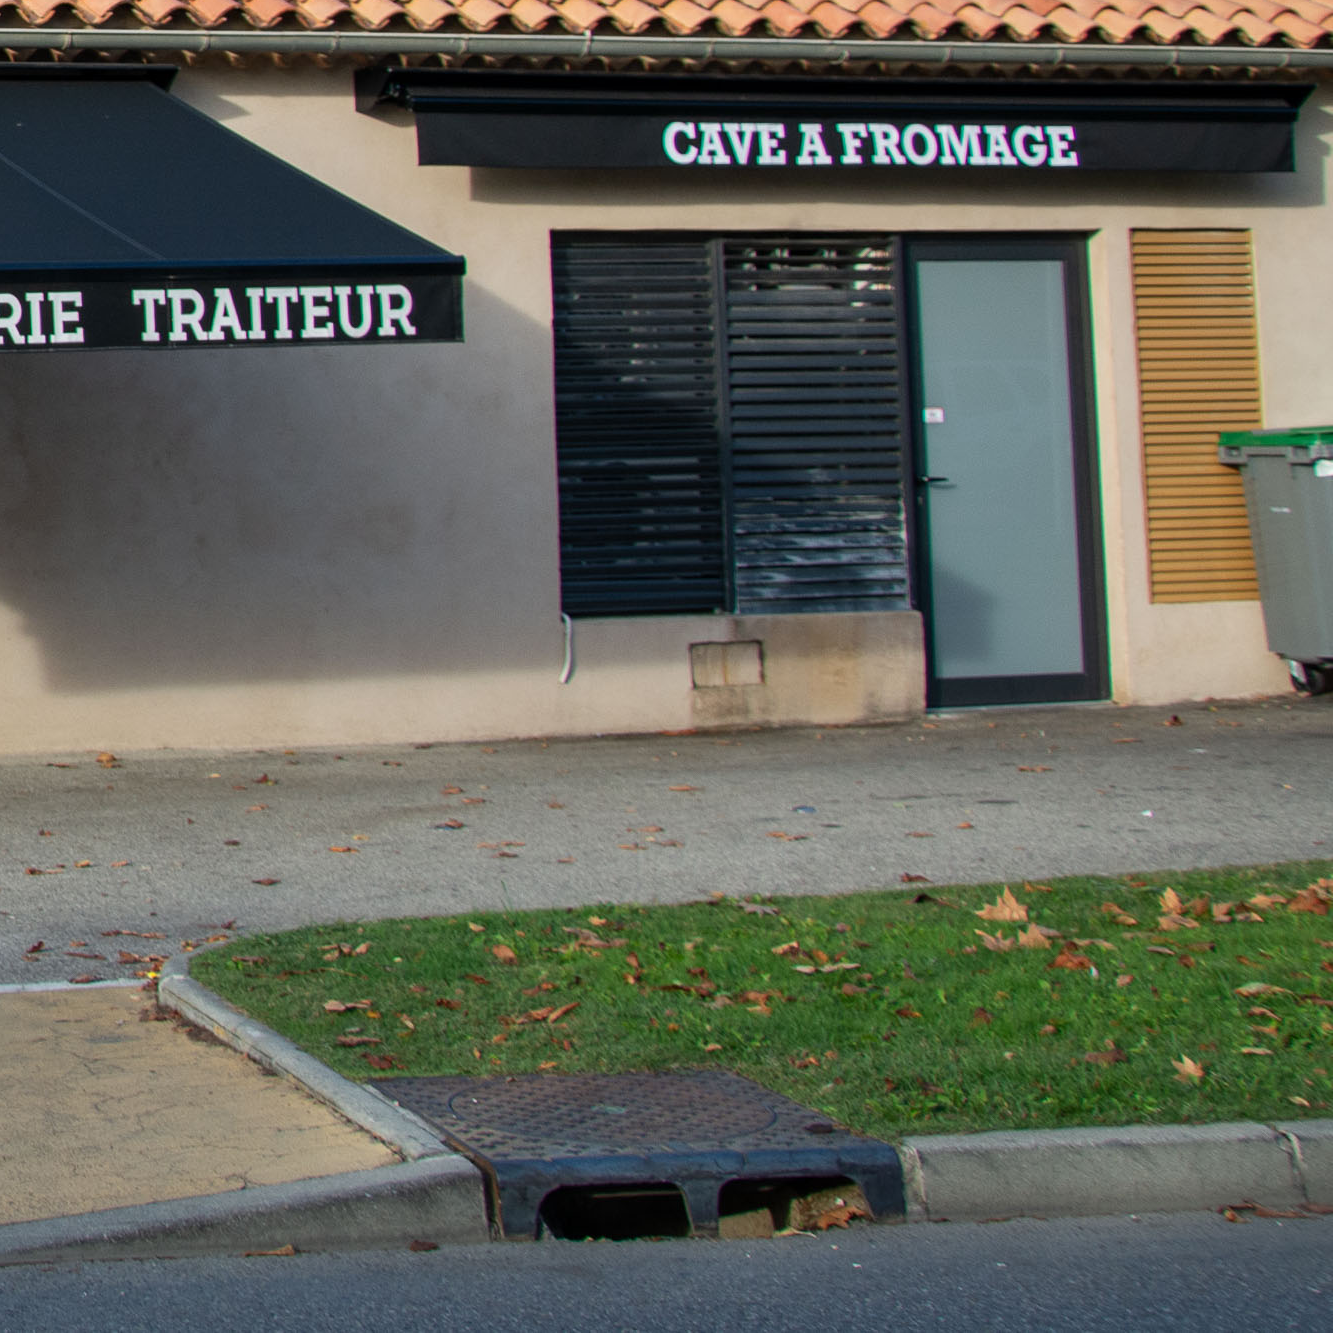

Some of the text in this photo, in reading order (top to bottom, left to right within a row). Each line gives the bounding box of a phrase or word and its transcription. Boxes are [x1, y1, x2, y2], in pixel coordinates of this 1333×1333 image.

[663, 121, 1079, 168] CAVE A FROMAGE
[131, 283, 418, 343] TRAITEUR
